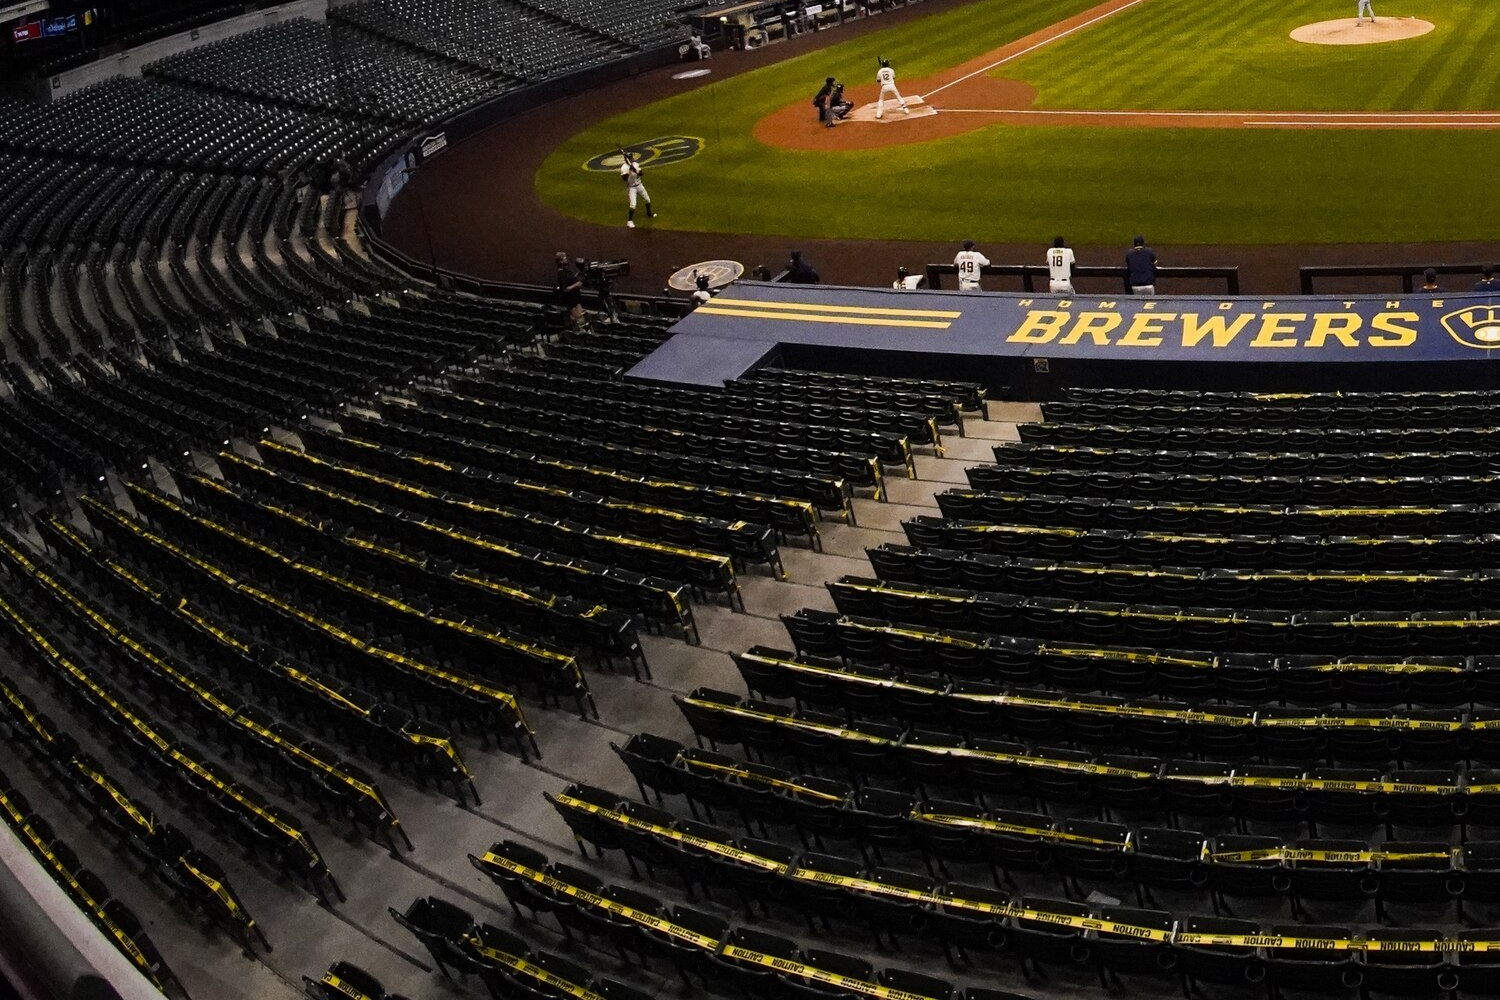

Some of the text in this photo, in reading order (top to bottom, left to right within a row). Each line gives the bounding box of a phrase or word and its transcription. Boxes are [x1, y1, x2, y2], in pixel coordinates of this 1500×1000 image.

[960, 261, 974, 273] 49
[1052, 255, 1063, 267] 18
[1005, 310, 1419, 348] BREWERS
[1113, 924, 1151, 939] CAUTION
[1243, 936, 1283, 947] CAUTION
[1295, 938, 1336, 950] CAUTION
[1380, 941, 1421, 951] CAUTION
[732, 947, 764, 964] CAUTION
